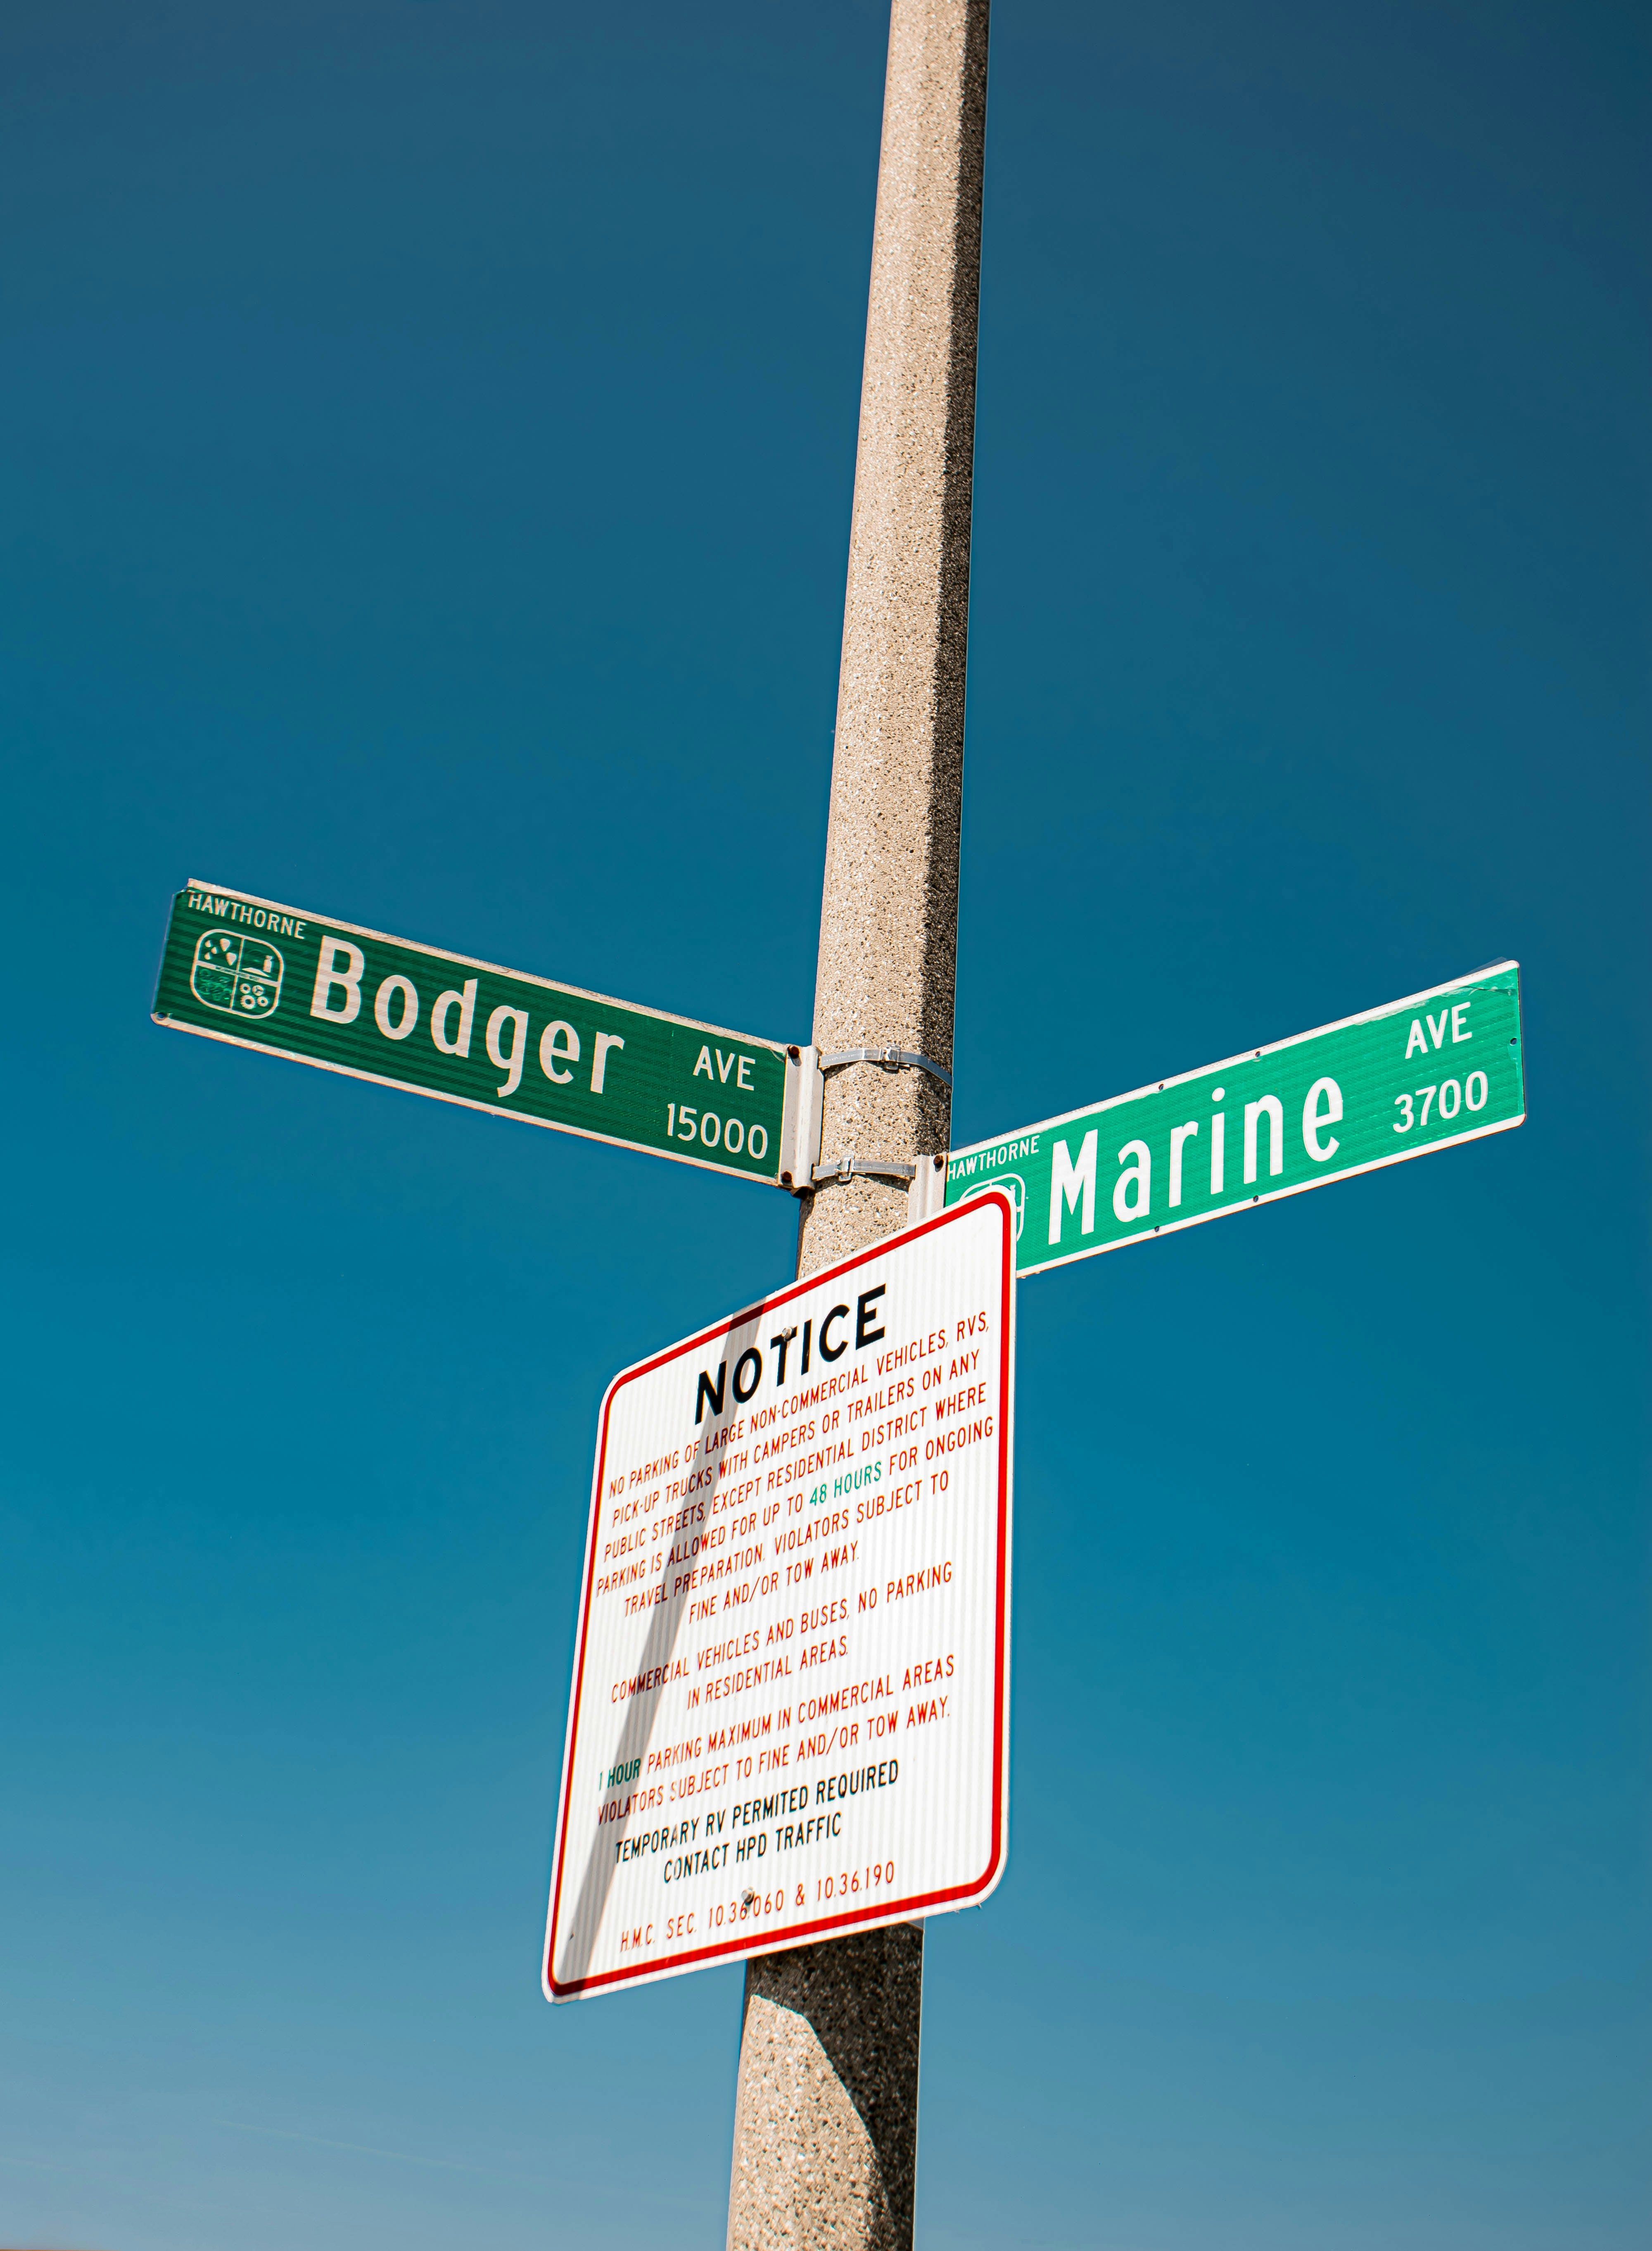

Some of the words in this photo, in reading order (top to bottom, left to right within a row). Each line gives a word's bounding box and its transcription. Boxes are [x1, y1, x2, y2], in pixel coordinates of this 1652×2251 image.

[188, 894, 306, 939] HAWTHORNE
[310, 935, 624, 1098] Bodger
[693, 1045, 755, 1091] AVE
[667, 1103, 768, 1159] 15000
[947, 1135, 1040, 1182] HAWTHORNE
[1048, 1077, 1343, 1245] Marine
[1405, 1001, 1472, 1059] AVE
[1393, 1071, 1488, 1133] 3700
[609, 1476, 624, 1499] NO
[630, 1450, 679, 1488] PARKING
[685, 1439, 701, 1462] OF
[705, 1419, 745, 1455] LARGE
[751, 1364, 868, 1433] NON-COMMERCIAL
[877, 1329, 948, 1375] VEHICLES,
[957, 1311, 988, 1341] RVS,
[695, 1283, 886, 1425] NOTICE
[605, 1528, 646, 1562] PUBLIC
[653, 1502, 705, 1540] STREETS,
[713, 1476, 762, 1514] EXCEPT
[768, 1438, 854, 1491] RESIDENTIAL
[862, 1406, 927, 1451] DISTRICT
[936, 1382, 986, 1420] WHERE
[613, 1490, 660, 1527] PICK-UP
[667, 1466, 712, 1503] TRUCKS
[719, 1450, 748, 1479] WITH
[754, 1421, 815, 1463] CAMPERS
[823, 1410, 840, 1433] OR
[847, 1377, 914, 1422] TRAILERS
[923, 1365, 941, 1390] ON
[949, 1349, 979, 1380] ANY
[598, 1559, 646, 1595] PARKING
[651, 1552, 662, 1573] IS
[667, 1526, 726, 1568] ALLOWED
[732, 1512, 757, 1539] FOR
[764, 1502, 780, 1526] UP
[788, 1493, 803, 1516] TO
[809, 1484, 826, 1506] 48
[834, 1461, 881, 1497] HOURS
[890, 1446, 918, 1475] FOR
[926, 1416, 993, 1460] ONGOING
[626, 1581, 668, 1616] TRAVEL
[775, 1509, 849, 1555] VIOLATORS
[857, 1480, 922, 1523] SUBJECT
[931, 1470, 948, 1494] TO
[612, 1657, 689, 1702] COMMERCIAL
[698, 1631, 760, 1670] VEHICLES
[767, 1618, 794, 1645] AND
[801, 1598, 849, 1633] BUSES,
[859, 1588, 877, 1613] NO
[887, 1561, 952, 1602] PARKING
[690, 1595, 717, 1623] FINE
[724, 1571, 779, 1610] AND/OR
[787, 1557, 814, 1585] TOW
[821, 1540, 859, 1573] AWAY.
[599, 1771, 603, 1791] 1
[608, 1757, 641, 1788] HOUR
[648, 1737, 702, 1773] PARKING
[708, 1714, 771, 1753] MAXIMUM
[779, 1707, 791, 1730] IN
[799, 1675, 893, 1723] COMMERCIAL
[903, 1654, 954, 1690] AREAS
[688, 1687, 700, 1709] IN
[706, 1656, 792, 1702] RESIDENTIAL
[599, 1785, 664, 1826] VIOLATORS
[670, 1764, 729, 1801] SUBJECT
[737, 1757, 752, 1780] TO
[760, 1744, 790, 1773] FINE
[798, 1723, 859, 1761] AND/OR
[868, 1710, 898, 1739] TOW
[907, 1695, 950, 1728] AWAY.
[615, 1817, 700, 1864] TEMPORARY
[706, 1809, 726, 1837] RV
[733, 1785, 809, 1829] PERMITED
[816, 1759, 899, 1804] REQUIRED
[664, 1842, 730, 1883] CONTACT
[736, 1832, 767, 1863] HPD
[776, 1811, 842, 1852] TRAFFIC
[796, 1883, 805, 1906] &
[818, 1861, 894, 1900] 10.36.190
